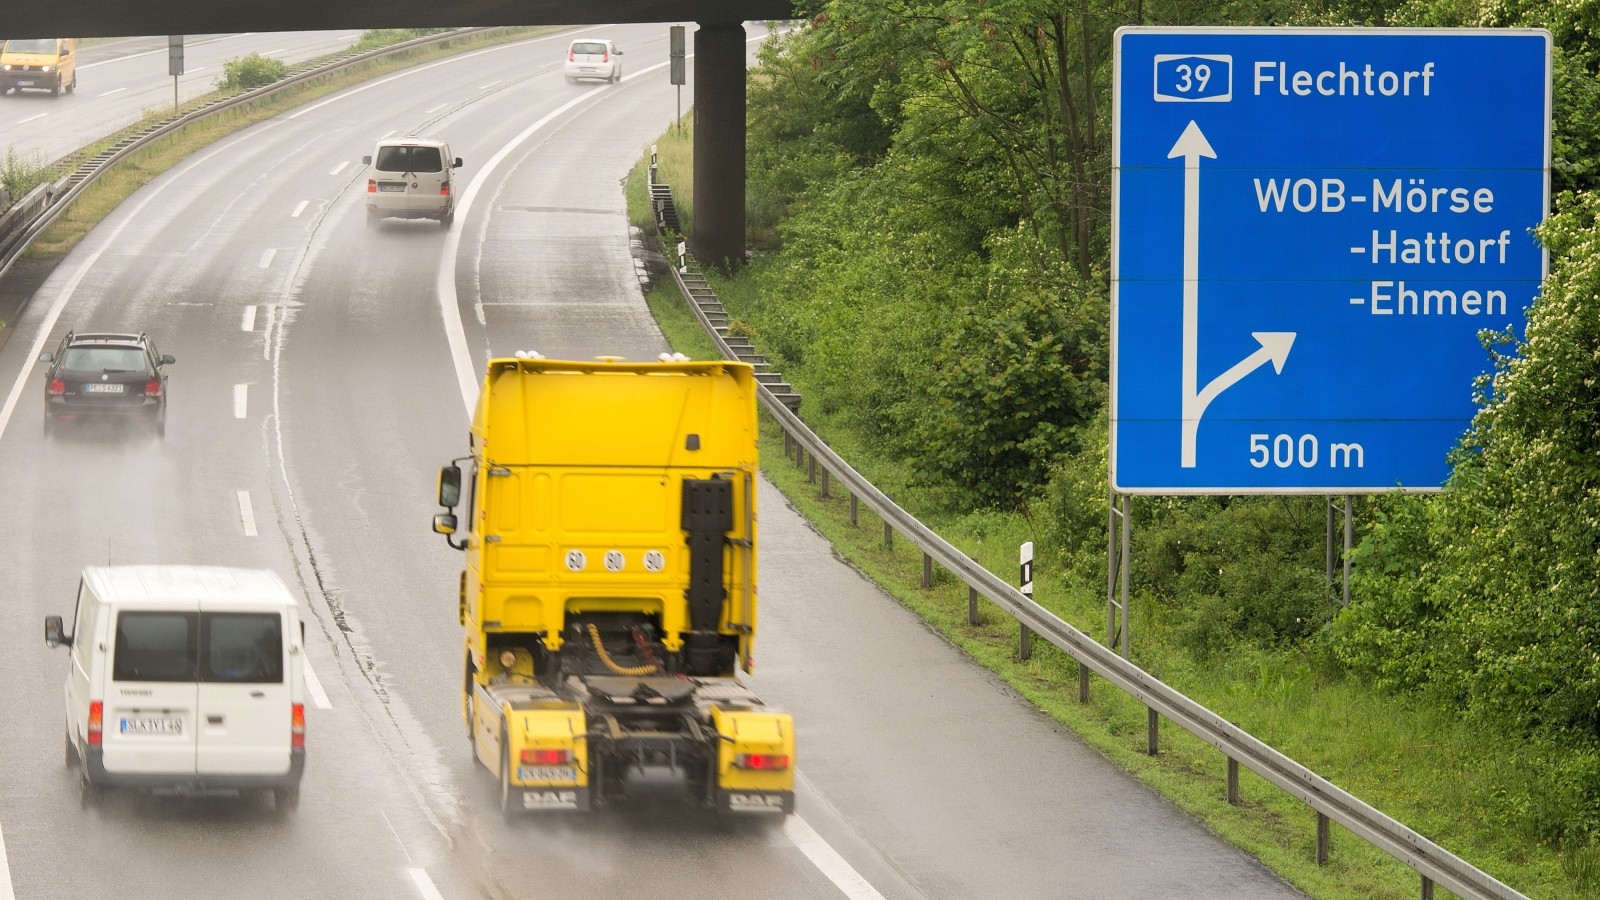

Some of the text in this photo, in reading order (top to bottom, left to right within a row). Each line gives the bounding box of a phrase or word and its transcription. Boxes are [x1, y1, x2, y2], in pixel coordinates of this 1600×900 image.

[1175, 61, 1435, 97] 39 Flechtorf
[1253, 178, 1495, 214] WOB-Mörse
[1350, 229, 1511, 264] -Hattorf
[1349, 280, 1508, 316] -Ehmen
[1249, 433, 1365, 469] 500 m
[522, 791, 578, 804] DAF
